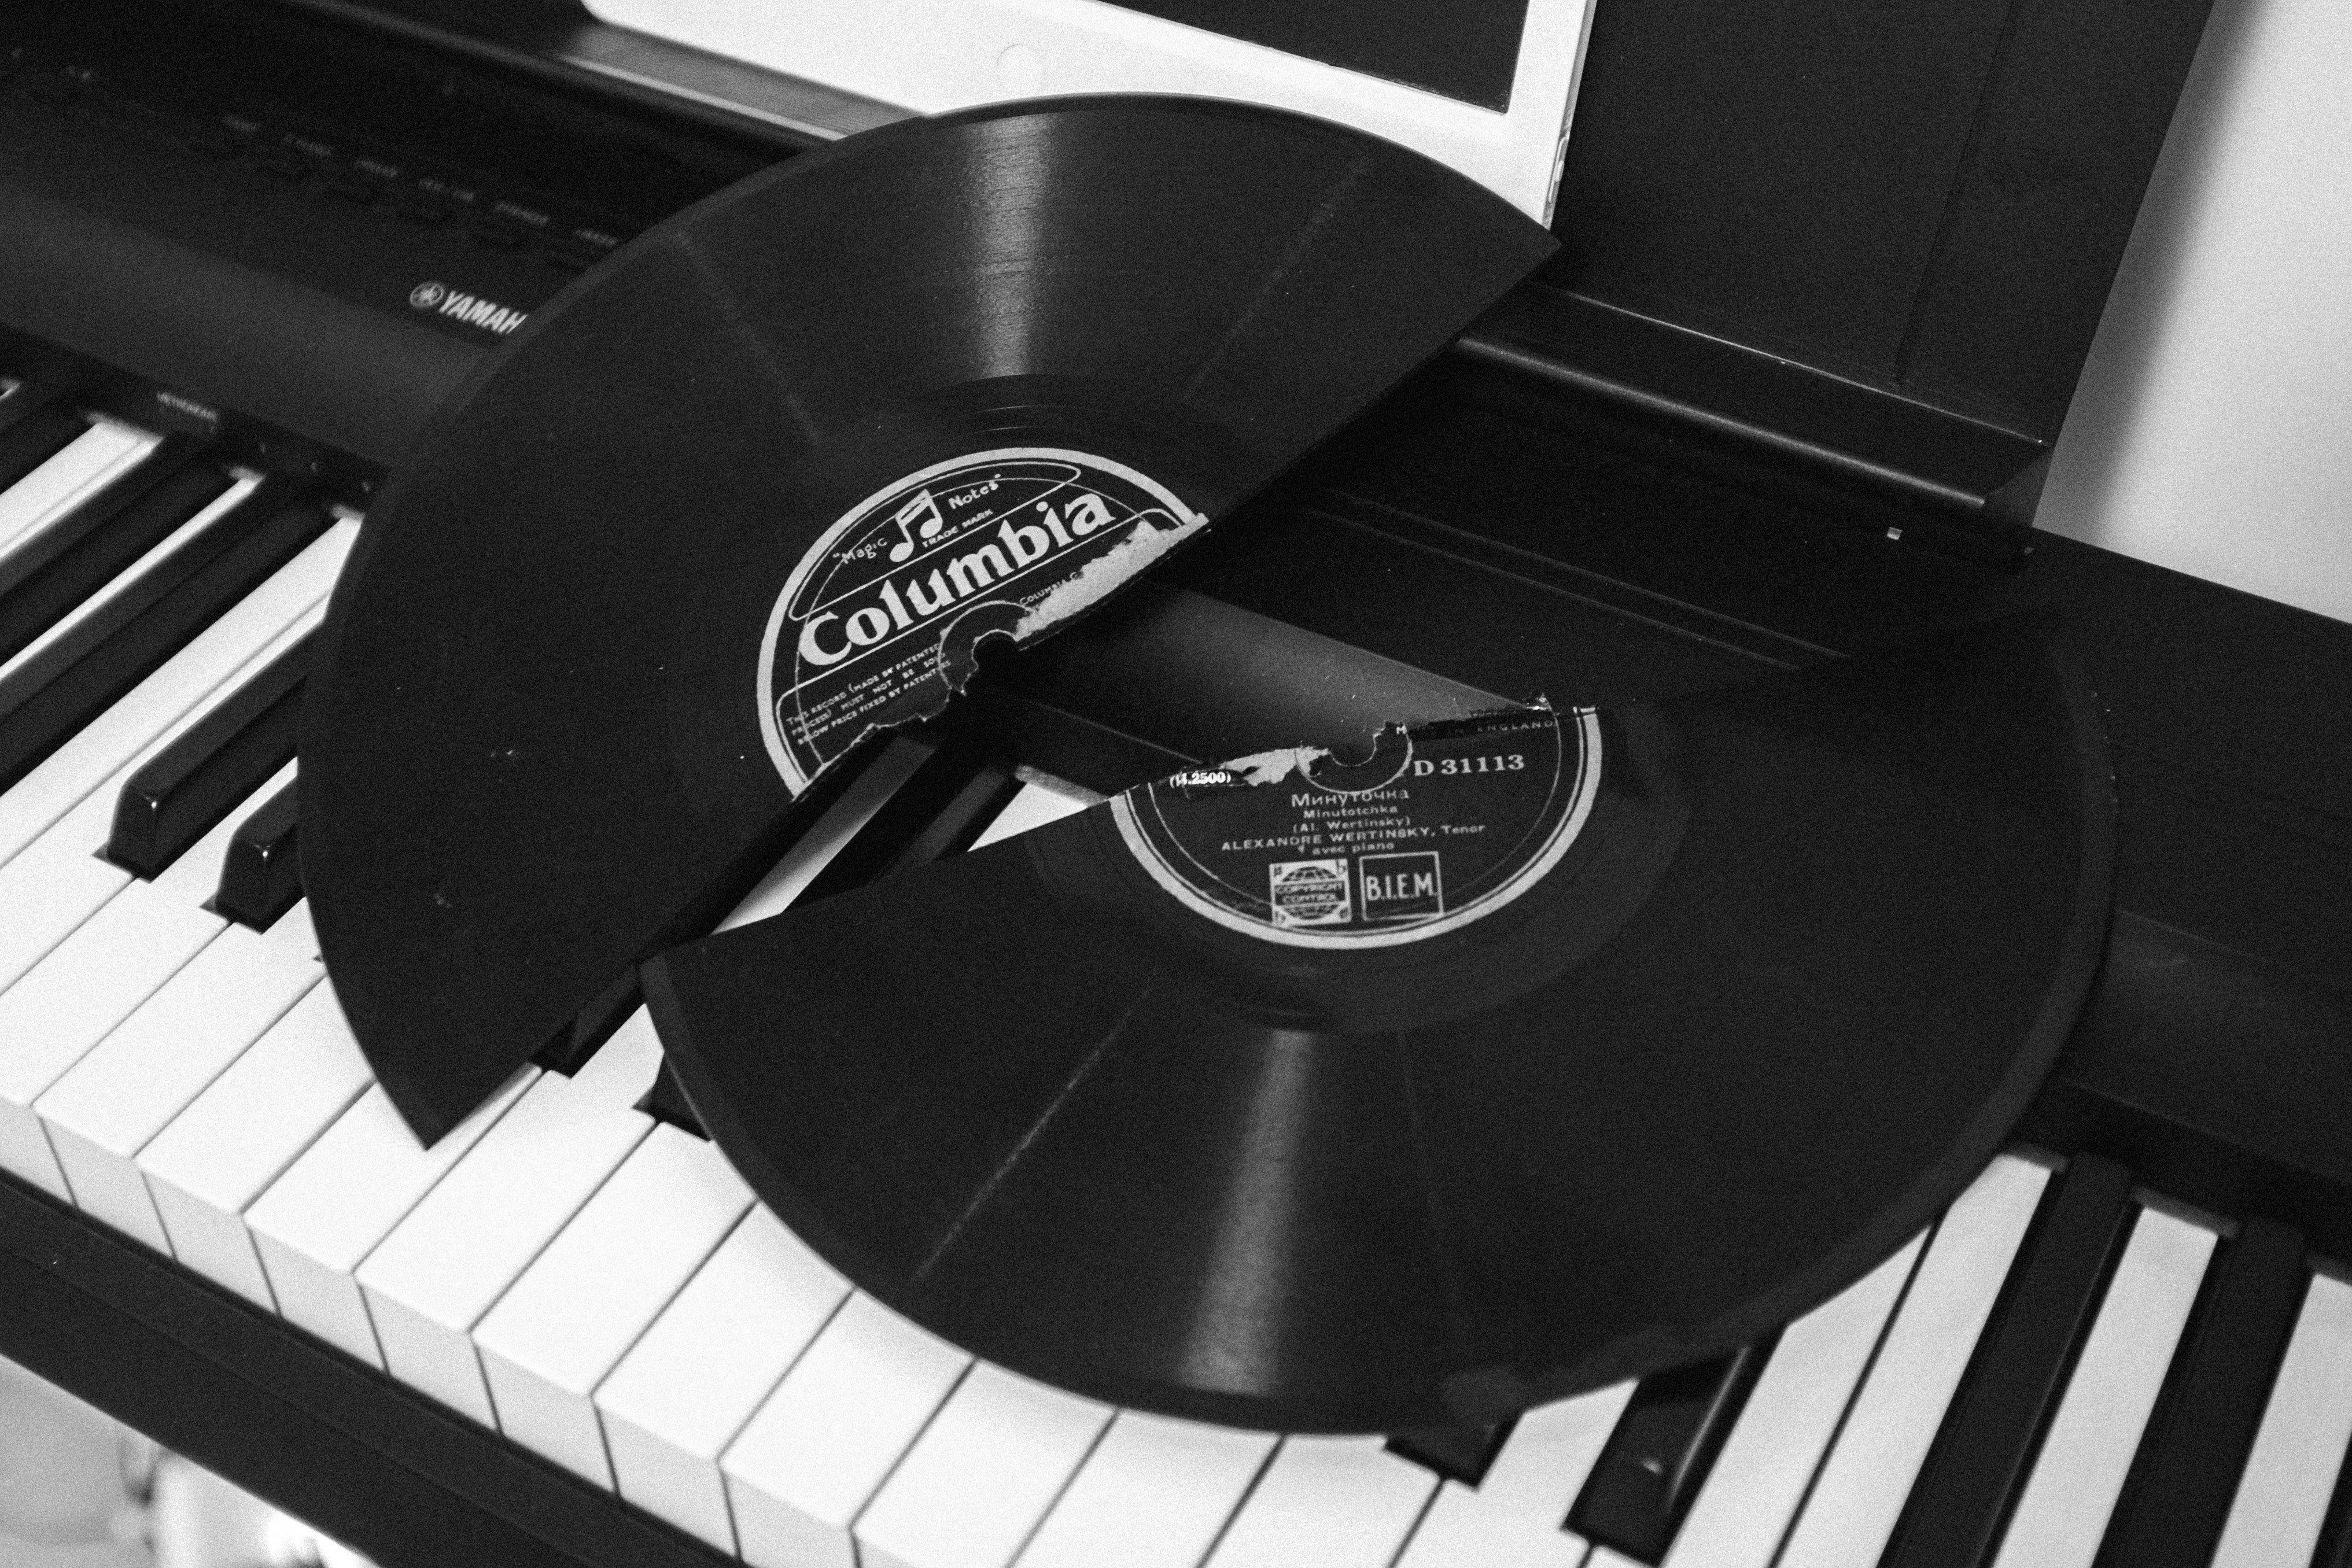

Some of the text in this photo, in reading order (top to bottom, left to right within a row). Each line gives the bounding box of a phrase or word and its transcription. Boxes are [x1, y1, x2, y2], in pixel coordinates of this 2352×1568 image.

[438, 290, 528, 335] YAMAH
[922, 509, 994, 548] TRADE MARK
[799, 493, 1116, 666] Columbia
[811, 692, 847, 714] RECORD
[840, 693, 864, 711] MUST
[872, 679, 892, 694] NOT
[902, 668, 915, 679] BE
[831, 710, 857, 728] PRICE
[859, 695, 887, 713] FIXED
[1414, 754, 1525, 777] D 31113
[1291, 789, 1410, 808] Минуточка
[1303, 805, 1398, 819] Minutotchka
[1221, 824, 1486, 851] ALEXANDRE WERTINSKY, Tenor
[1312, 842, 1395, 855] avec piano
